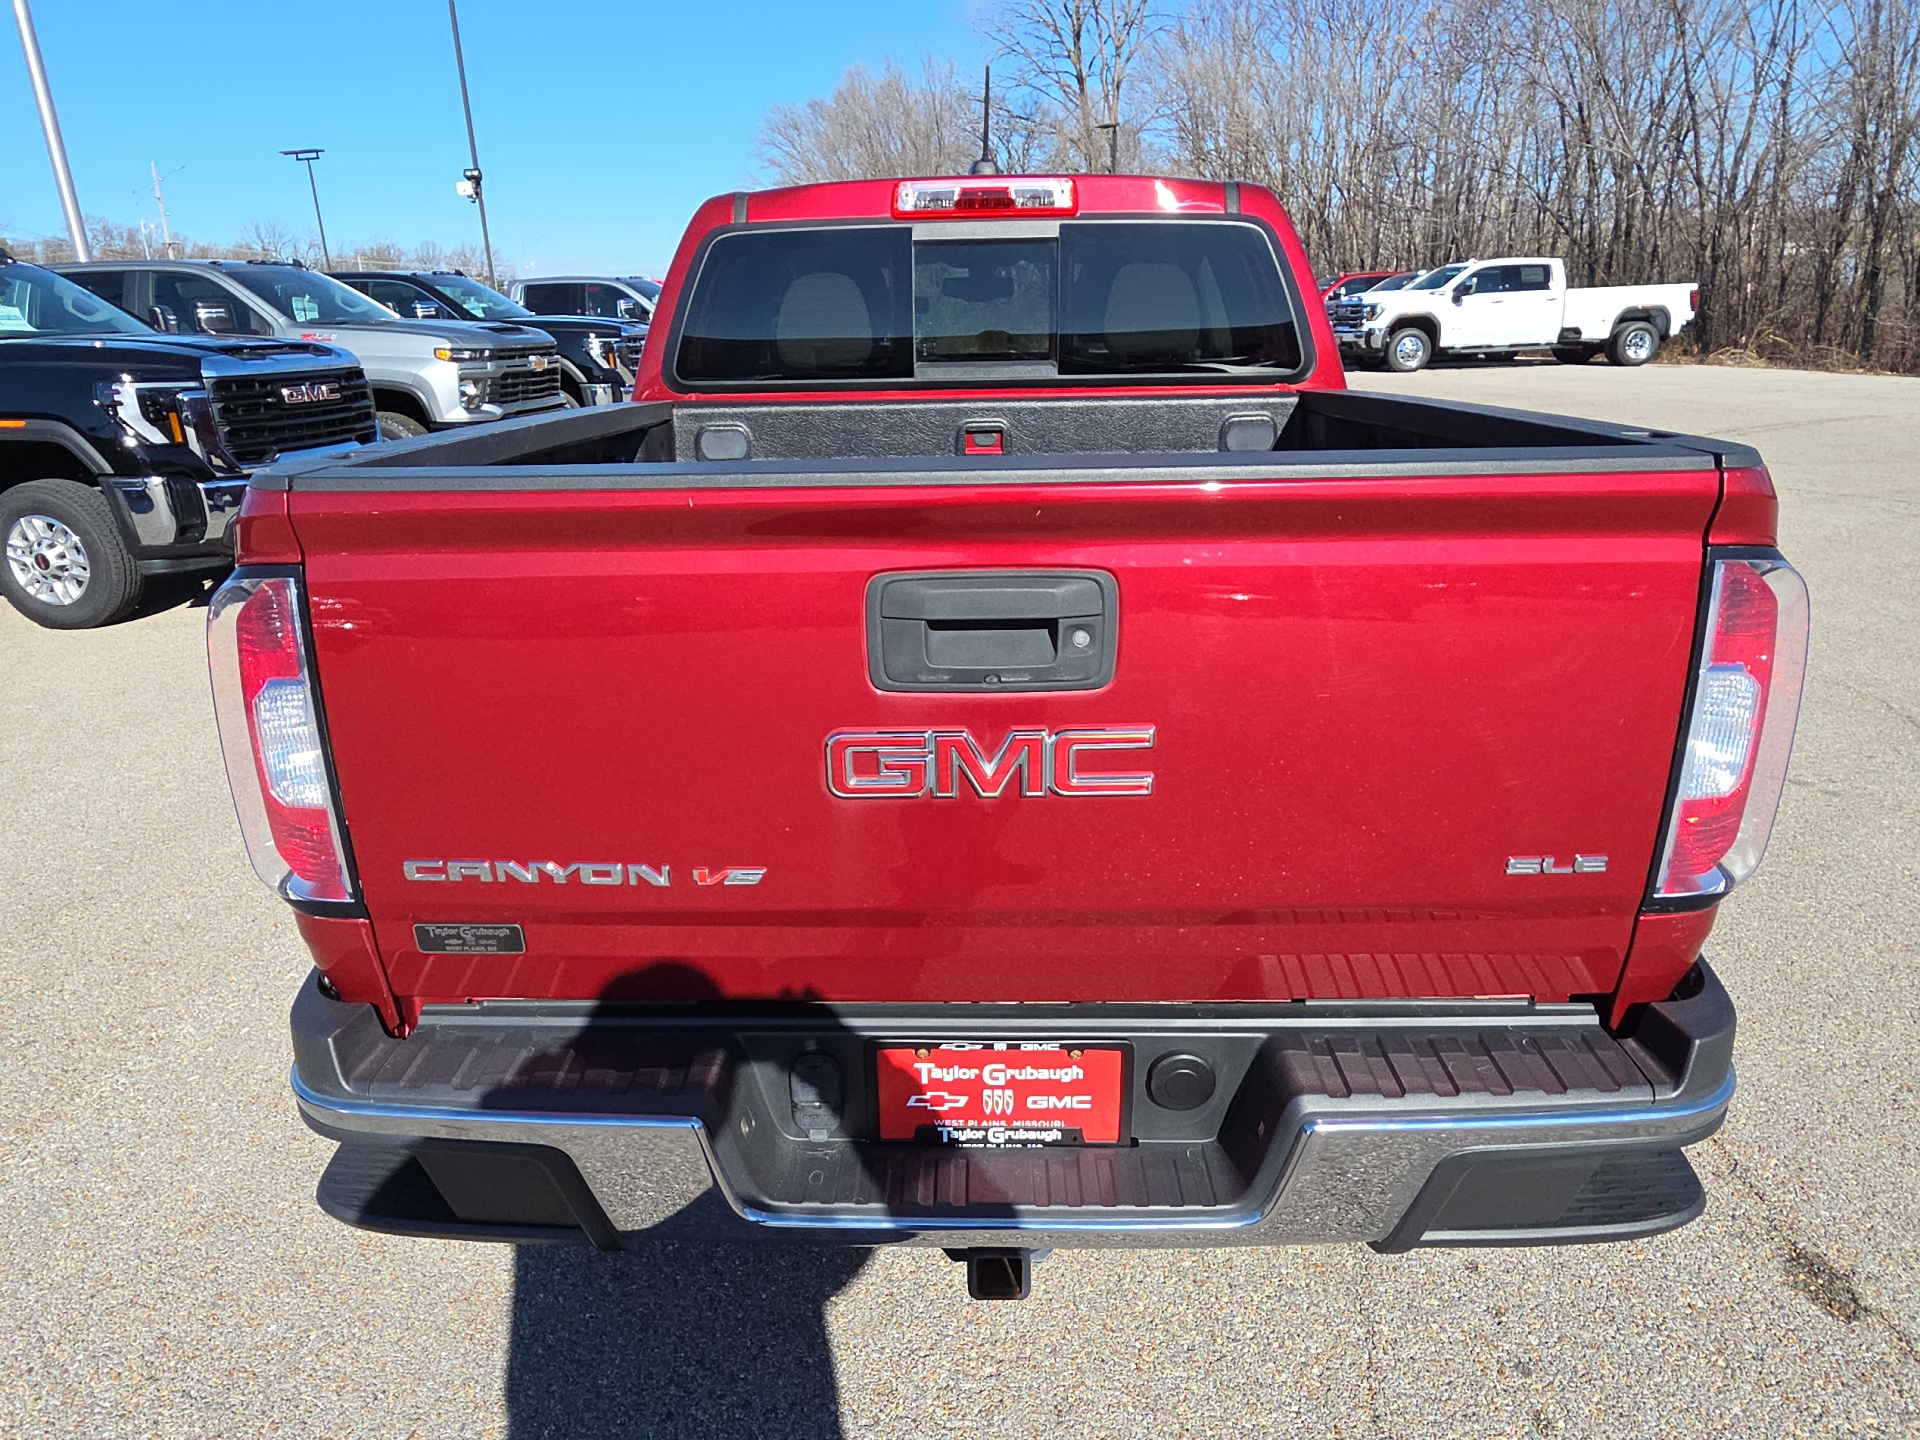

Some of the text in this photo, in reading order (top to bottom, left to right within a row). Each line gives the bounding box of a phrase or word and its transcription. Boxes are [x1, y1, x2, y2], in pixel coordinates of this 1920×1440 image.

[281, 382, 341, 403] GMC
[824, 725, 1155, 798] GMC
[403, 859, 767, 886] CANYON V6
[1506, 854, 1608, 874] SLE
[425, 926, 510, 938] Taylor Grubaugh
[1020, 1043, 1060, 1051] GMC
[913, 1062, 1084, 1086] Taylor Grubaugh
[1026, 1095, 1092, 1109] GMC
[934, 1119, 965, 1127] WEST
[937, 1127, 1062, 1143] Taylor Grubaugh
